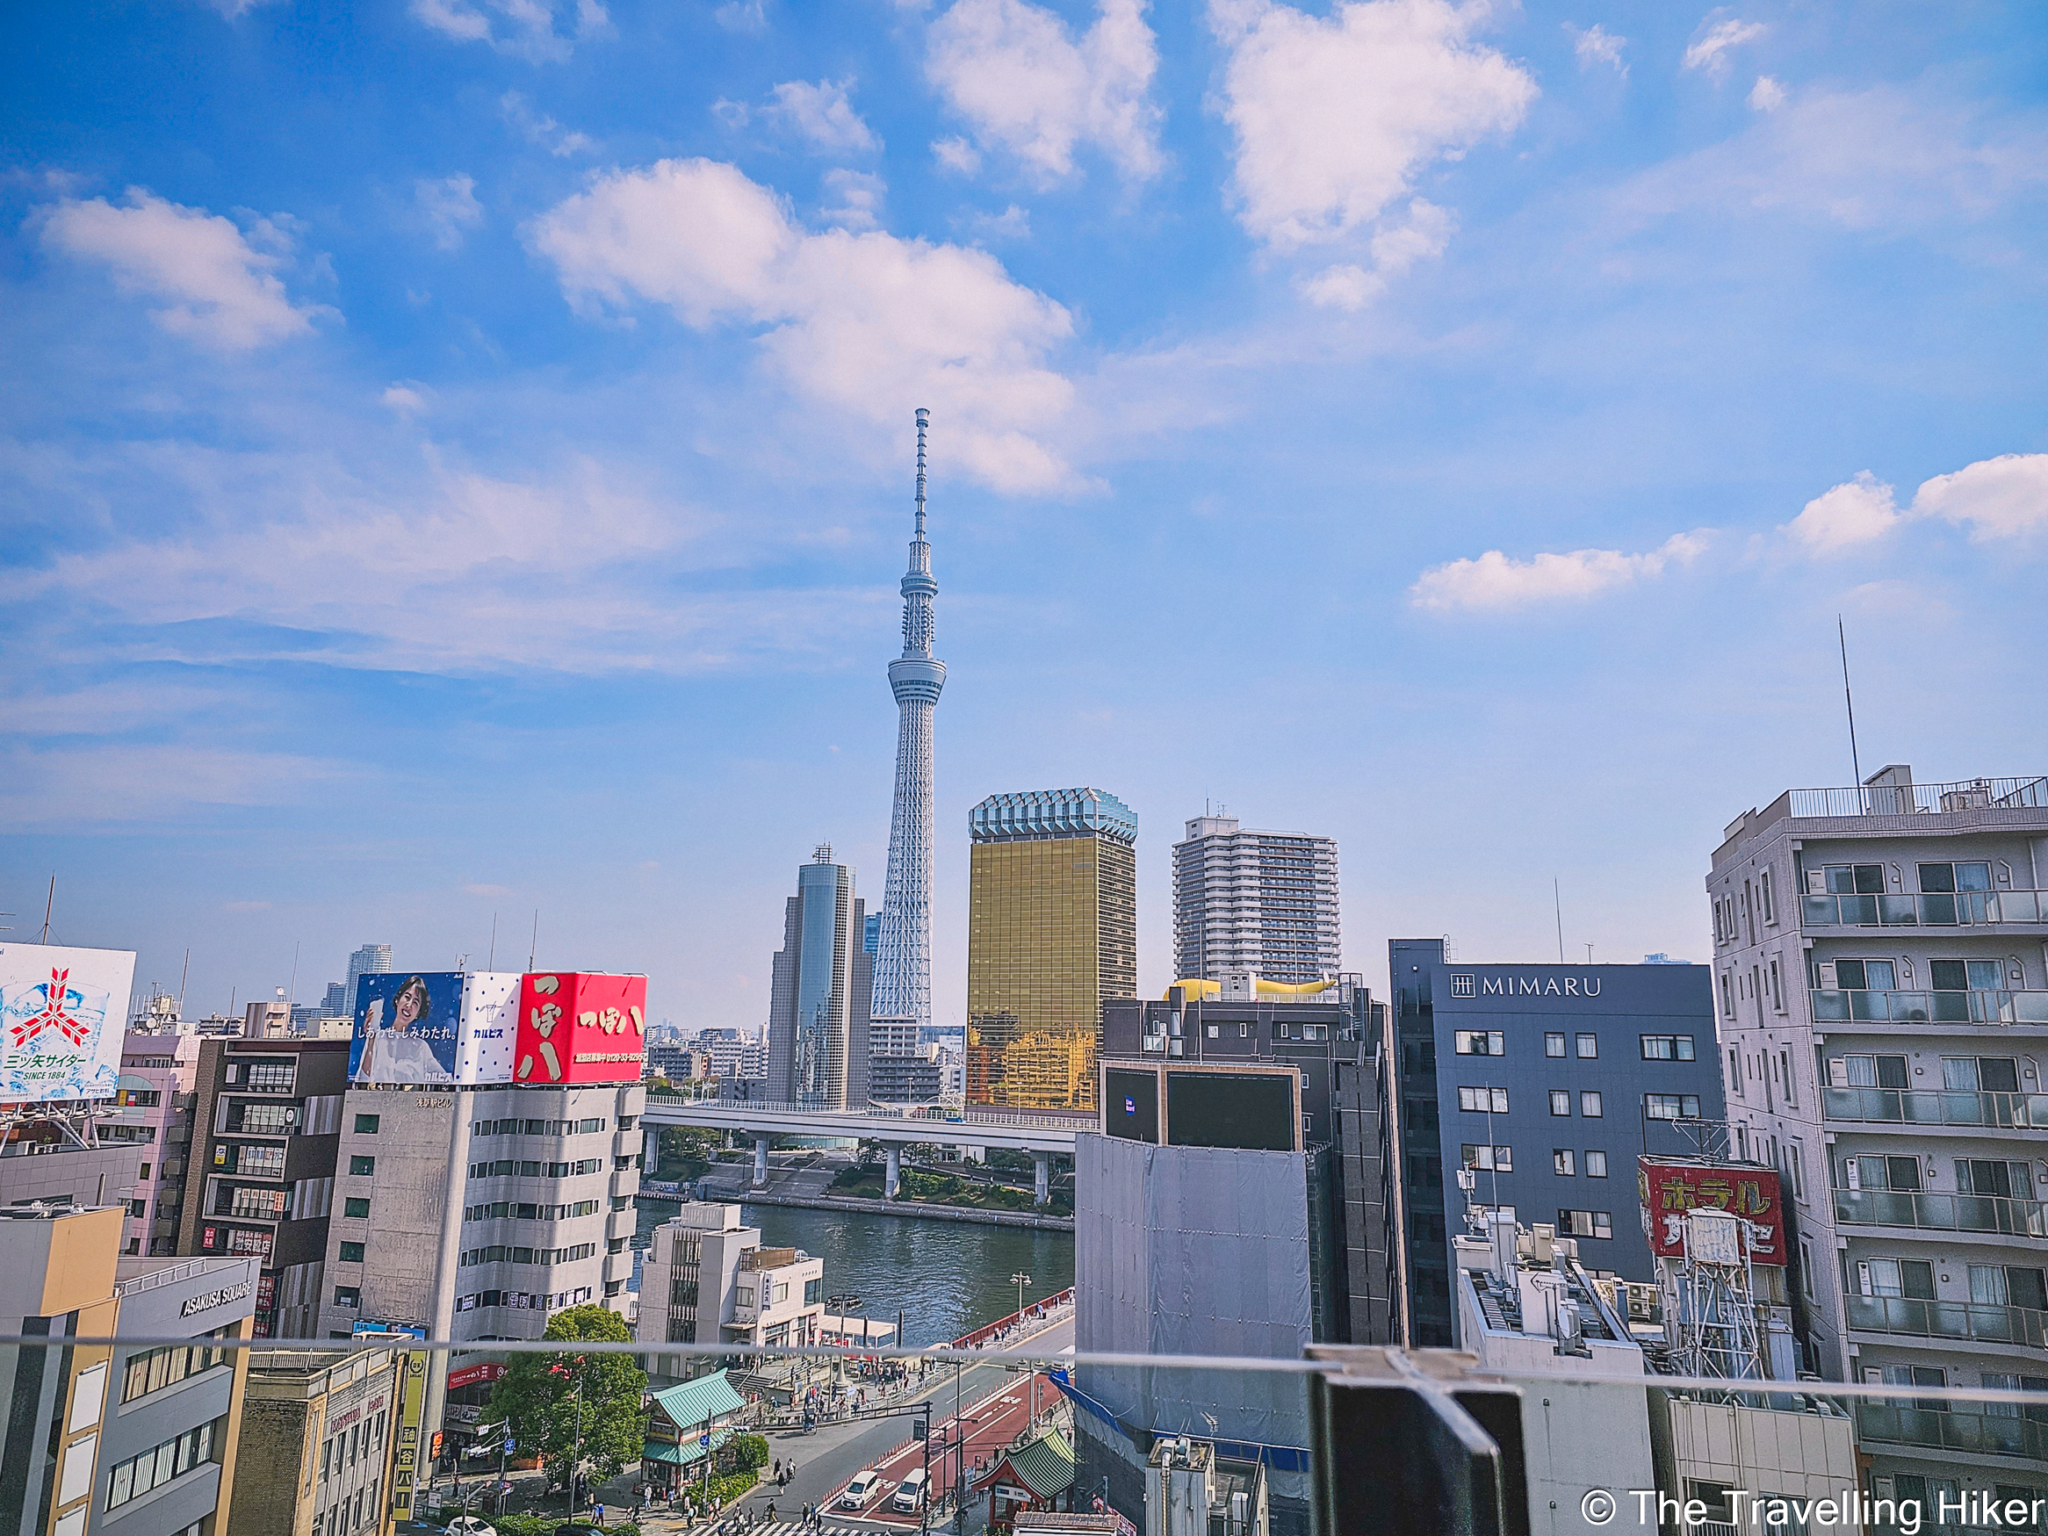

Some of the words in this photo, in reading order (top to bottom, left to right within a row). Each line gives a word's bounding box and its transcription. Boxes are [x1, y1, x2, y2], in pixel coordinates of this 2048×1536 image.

[1482, 976, 1601, 997] MIMARU
[358, 1025, 456, 1041] しあわせ、しみわたれ。
[473, 1029, 503, 1039] カルピス
[4, 1054, 86, 1069] 三ツ矢サイダー
[23, 1072, 46, 1080] SINCE
[48, 1071, 66, 1080] 1884
[1660, 1176, 1771, 1215] ホテル
[184, 1291, 222, 1314] ASAKUSA
[222, 1280, 252, 1304] SQUARE
[398, 1428, 415, 1507] 神谷バー
